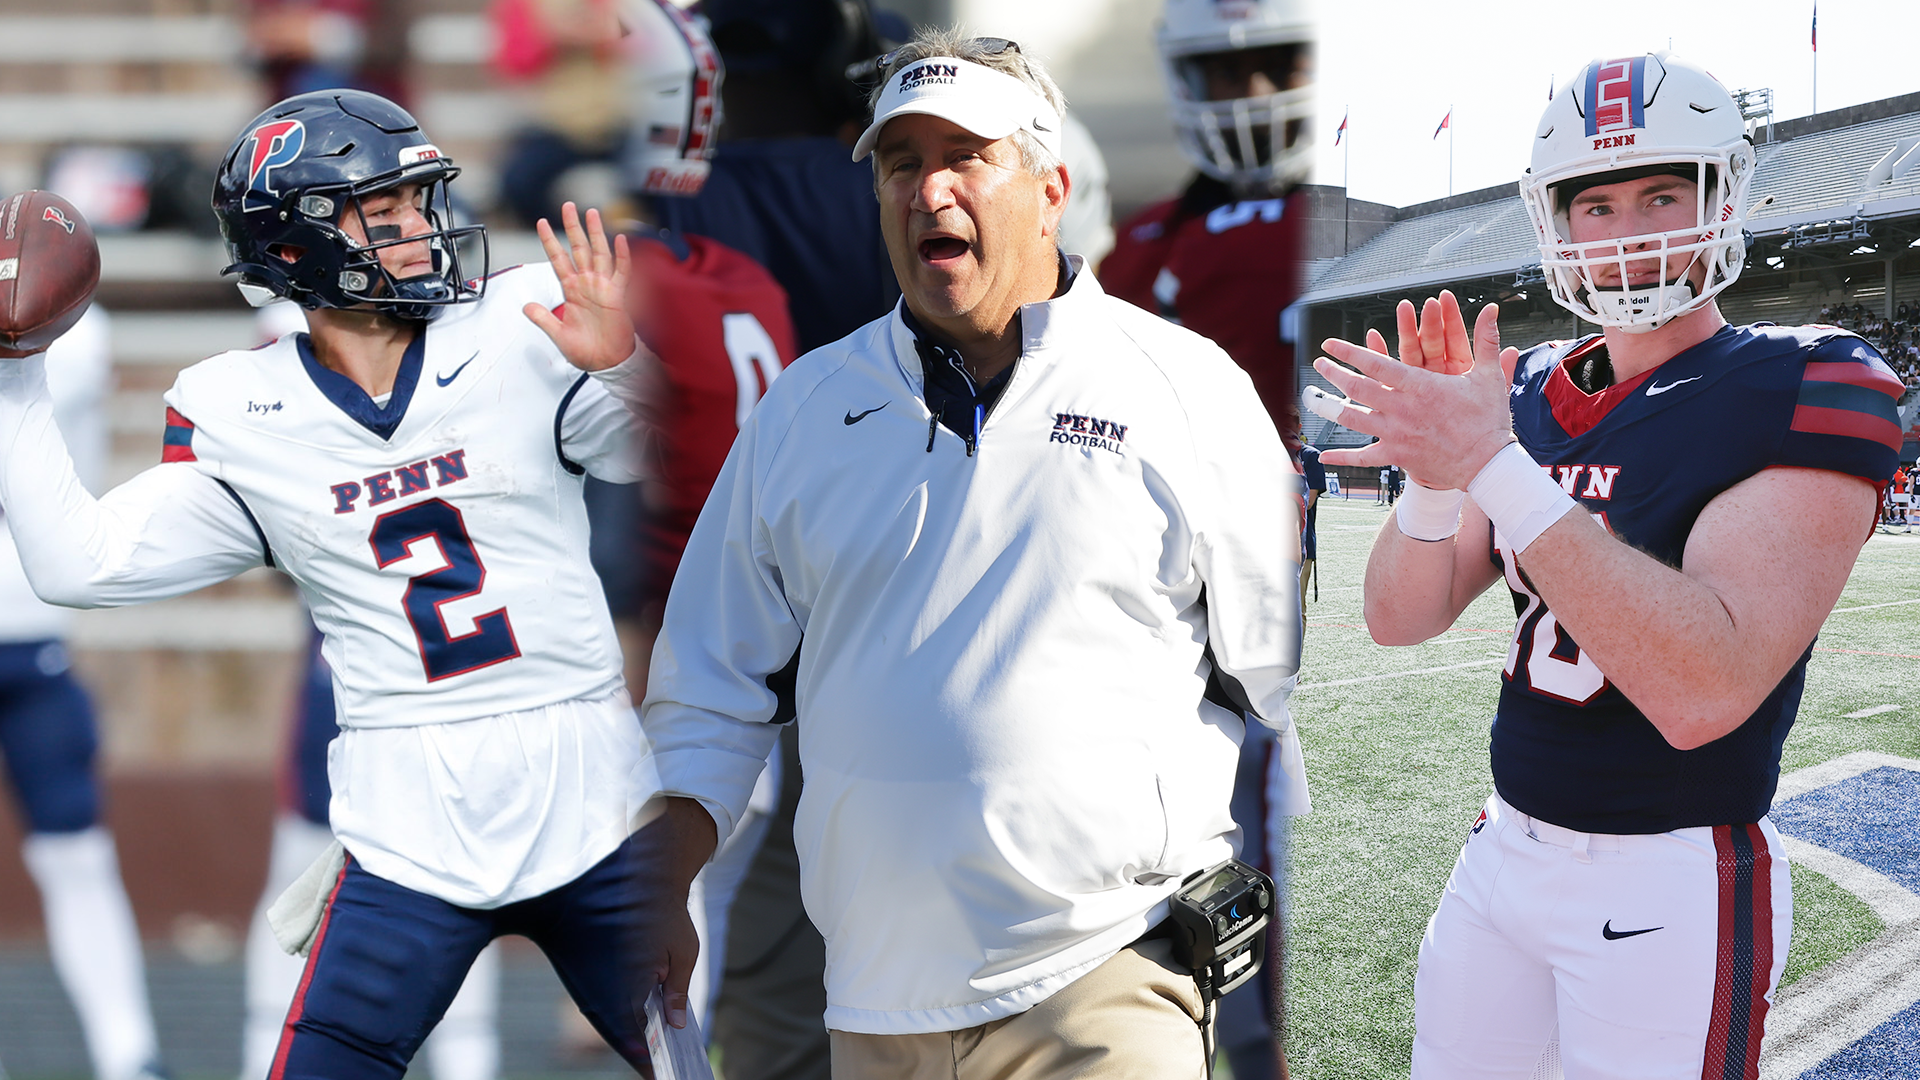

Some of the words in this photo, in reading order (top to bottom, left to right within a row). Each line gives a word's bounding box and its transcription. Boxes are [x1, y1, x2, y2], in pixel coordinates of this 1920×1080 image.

[899, 77, 957, 94] FOOTBALL
[900, 64, 958, 86] PENN
[1593, 133, 1636, 151] PENN
[247, 400, 271, 416] Ivy
[1053, 412, 1129, 443] PENN
[1049, 431, 1124, 456] FOOTBALL
[330, 448, 469, 515] PENN
[368, 497, 522, 683] 2
